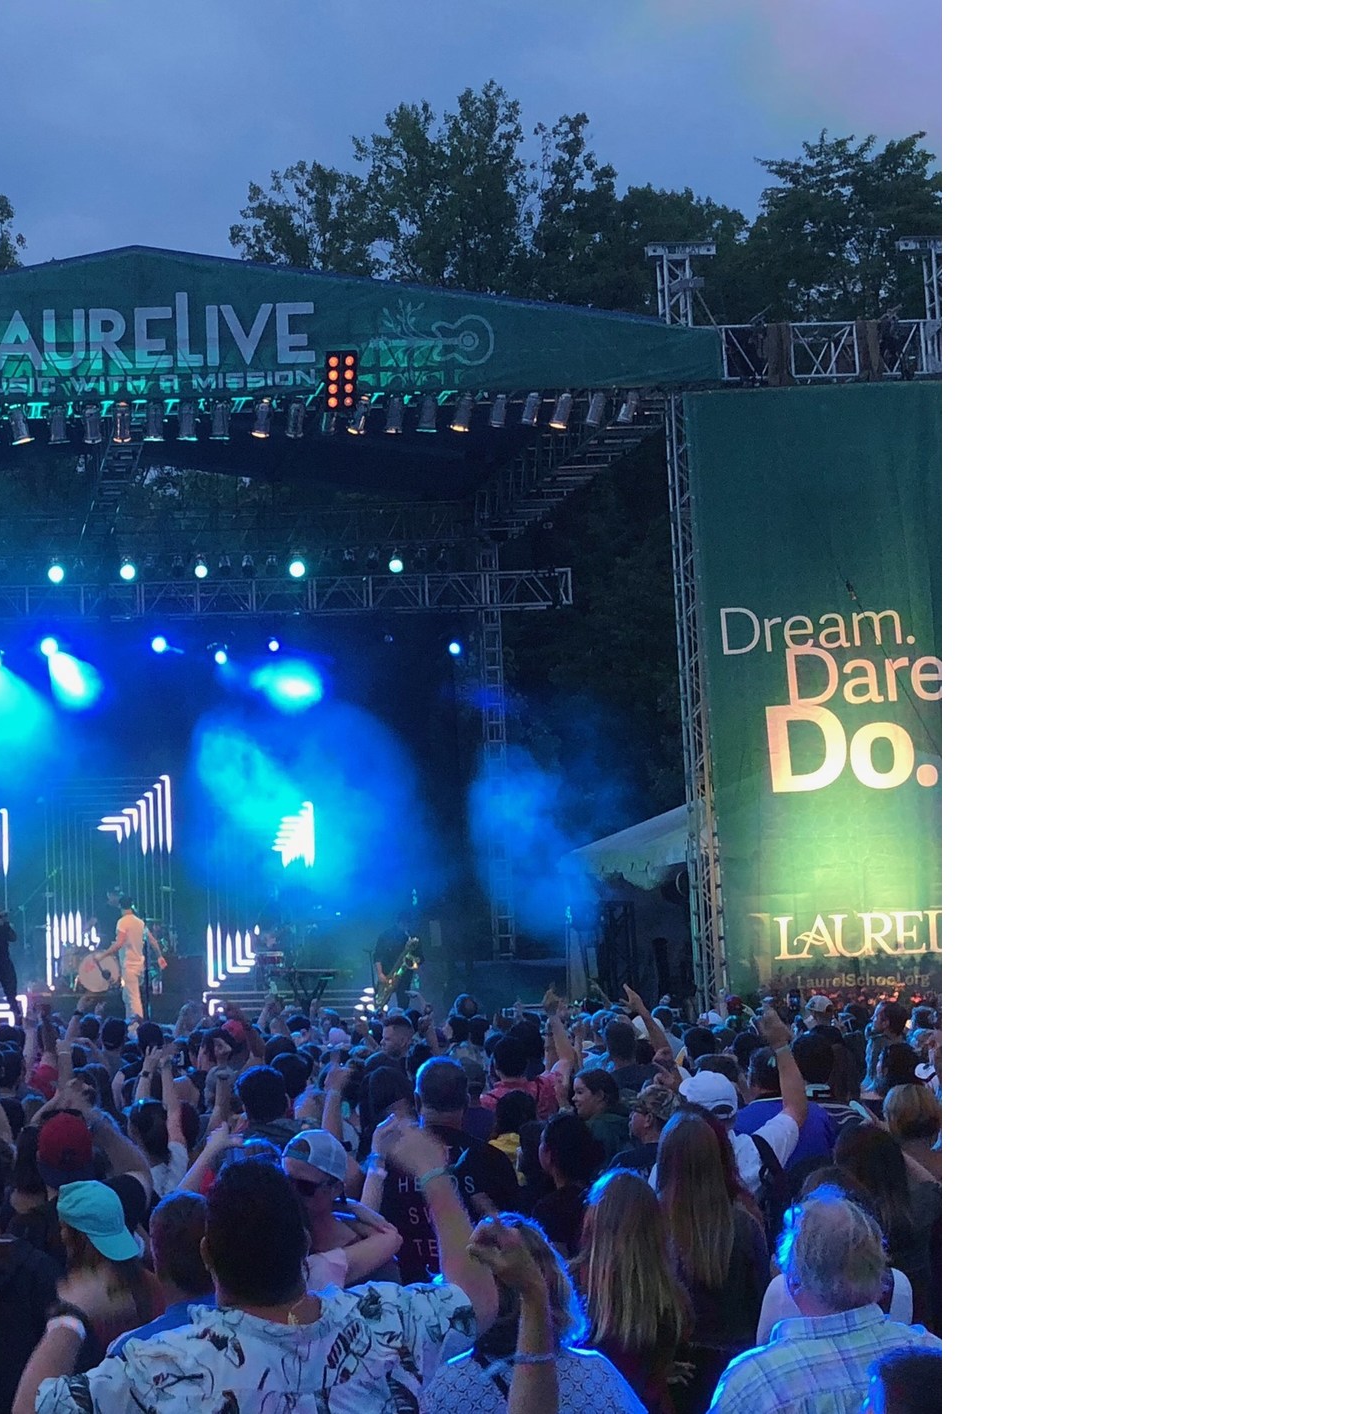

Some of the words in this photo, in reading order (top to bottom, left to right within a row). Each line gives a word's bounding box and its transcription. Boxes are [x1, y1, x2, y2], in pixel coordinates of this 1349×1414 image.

[70, 375, 147, 394] WITH
[159, 374, 181, 393] A
[192, 368, 316, 390] MISSION
[720, 607, 916, 656] Dream.
[765, 703, 939, 793] Do.
